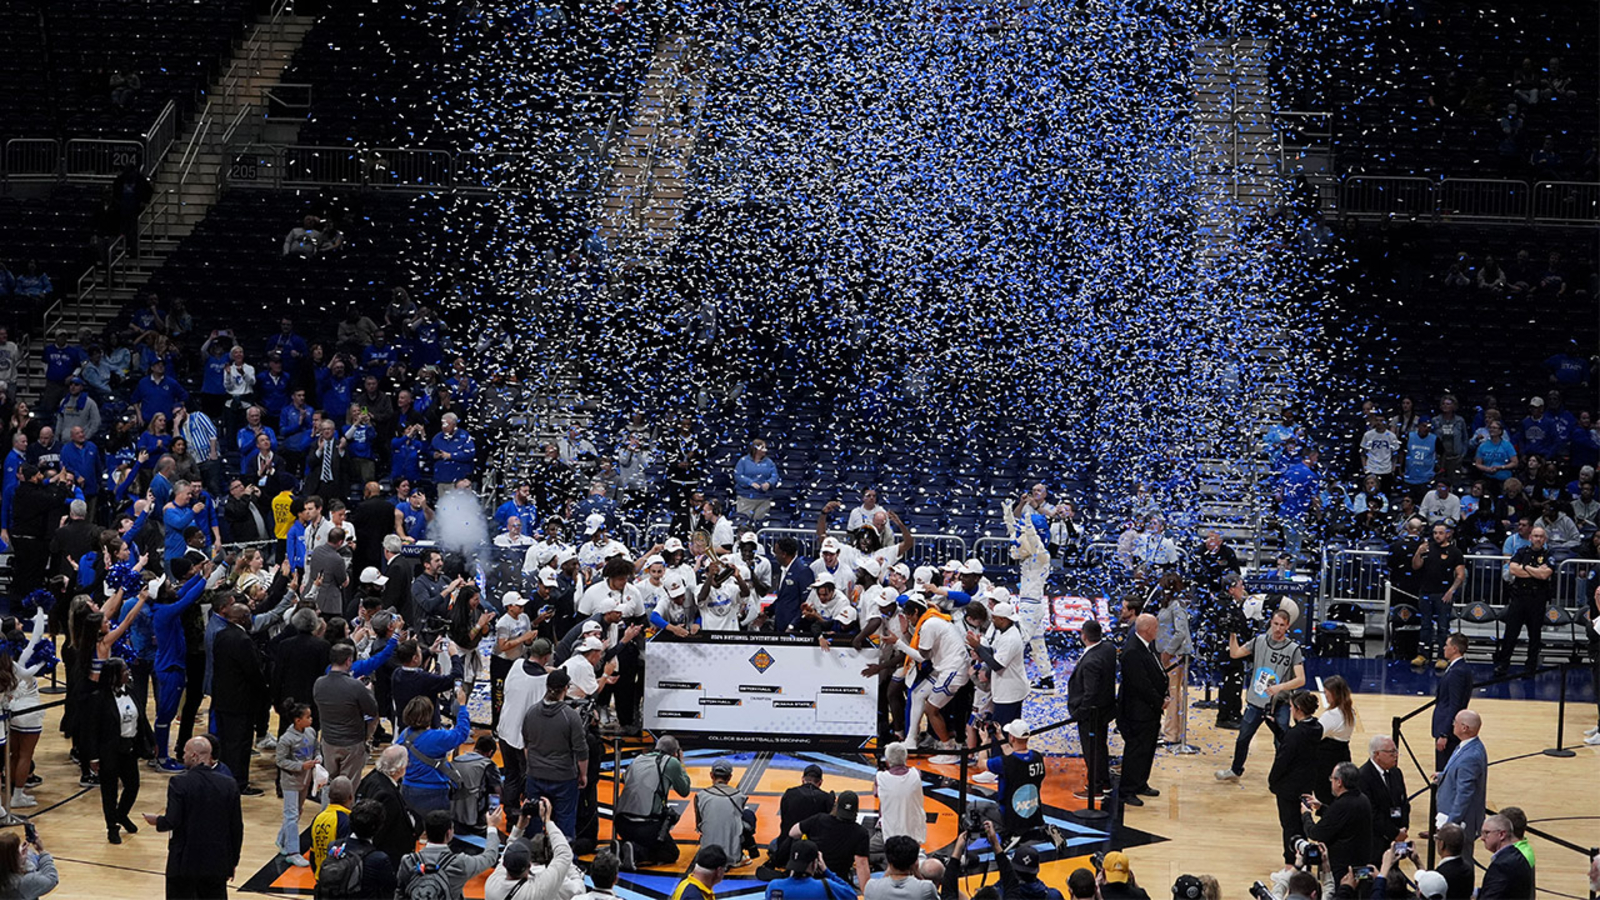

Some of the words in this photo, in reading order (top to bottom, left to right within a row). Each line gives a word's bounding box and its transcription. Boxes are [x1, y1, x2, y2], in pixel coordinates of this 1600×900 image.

[112, 152, 136, 166] 204
[232, 164, 256, 179] 205
[1414, 450, 1424, 460] 21
[275, 503, 289, 511] CSC
[1270, 652, 1291, 667] 573
[1029, 762, 1044, 777] 571
[315, 823, 331, 835] CSC
